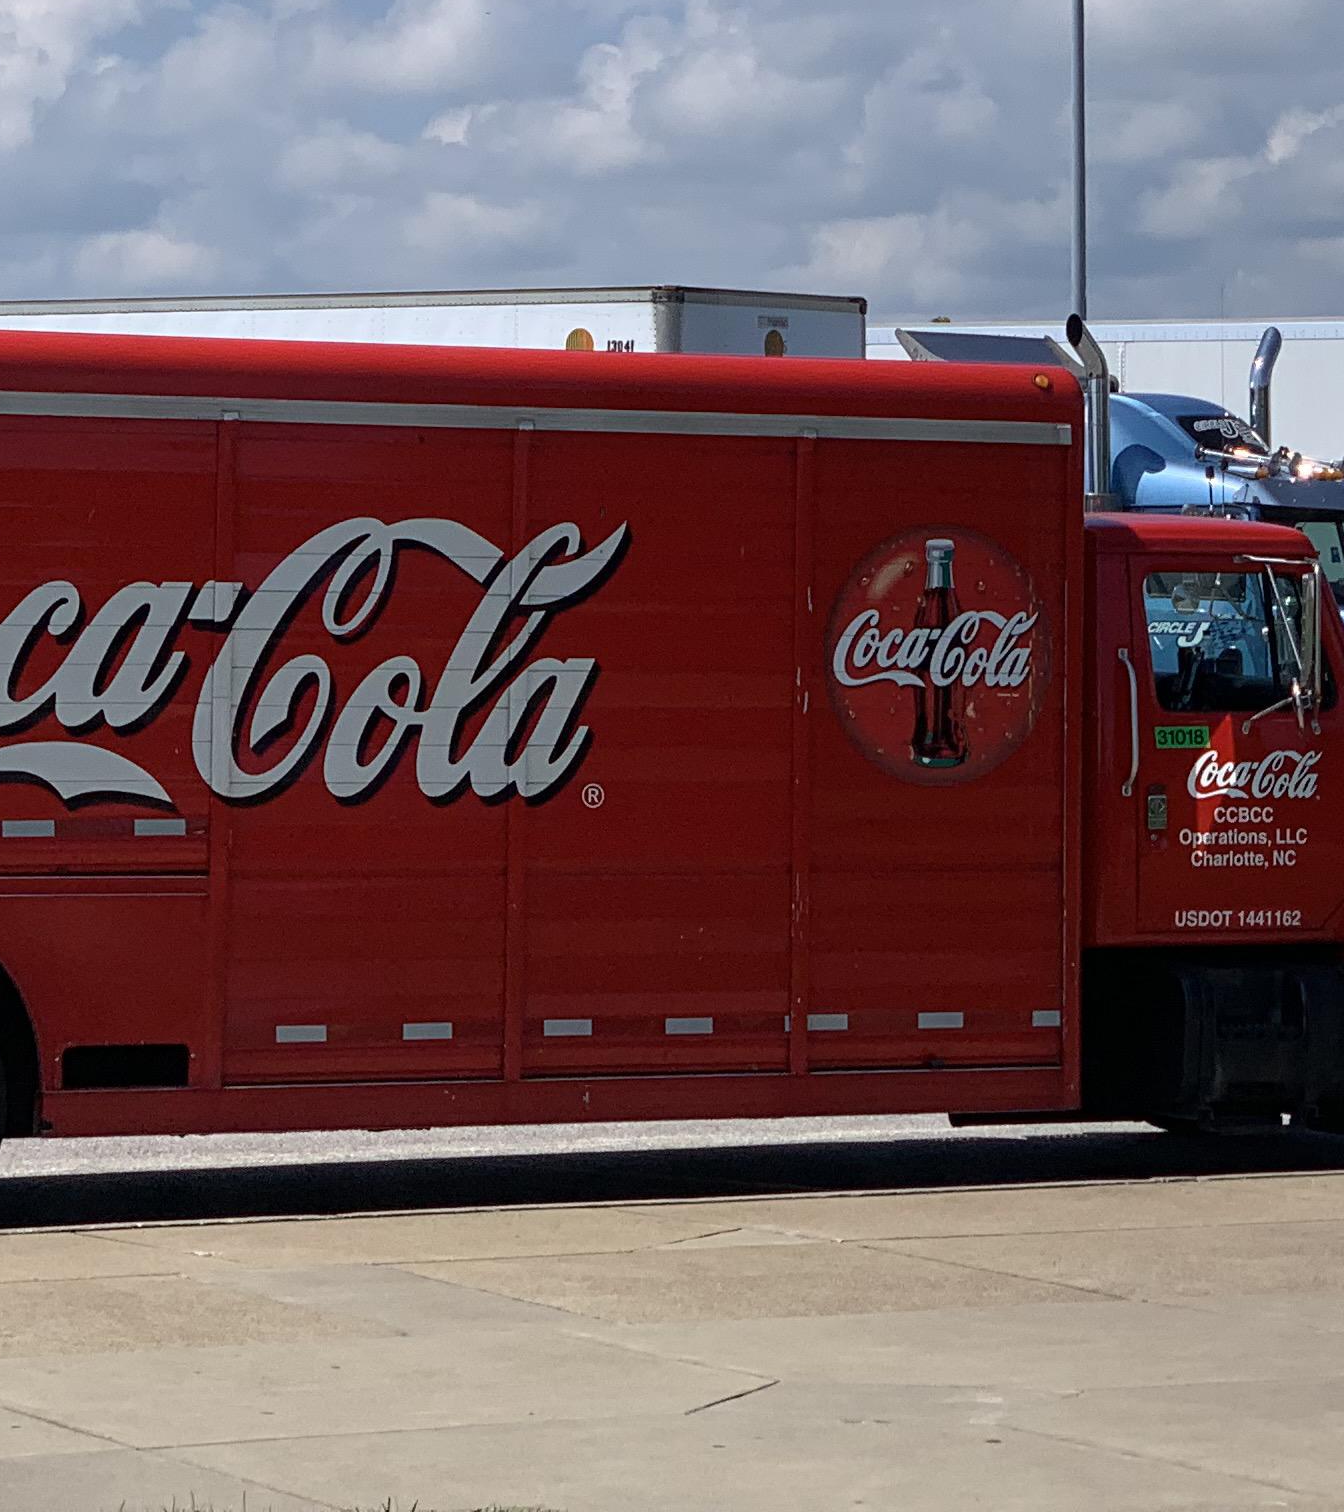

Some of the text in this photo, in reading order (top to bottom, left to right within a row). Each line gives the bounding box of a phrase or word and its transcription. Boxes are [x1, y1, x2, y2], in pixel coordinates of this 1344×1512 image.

[1148, 621, 1211, 648] CIRCLE J
[833, 609, 1039, 688] Coca-Cola
[1157, 728, 1205, 746] 31018
[1187, 749, 1323, 799] Coca-Cola
[1214, 806, 1274, 823] CCBCC
[1179, 828, 1307, 848] Operations, LLC
[1191, 850, 1297, 869] Charlotte, NC
[1175, 910, 1302, 928] USDOT 1441162
